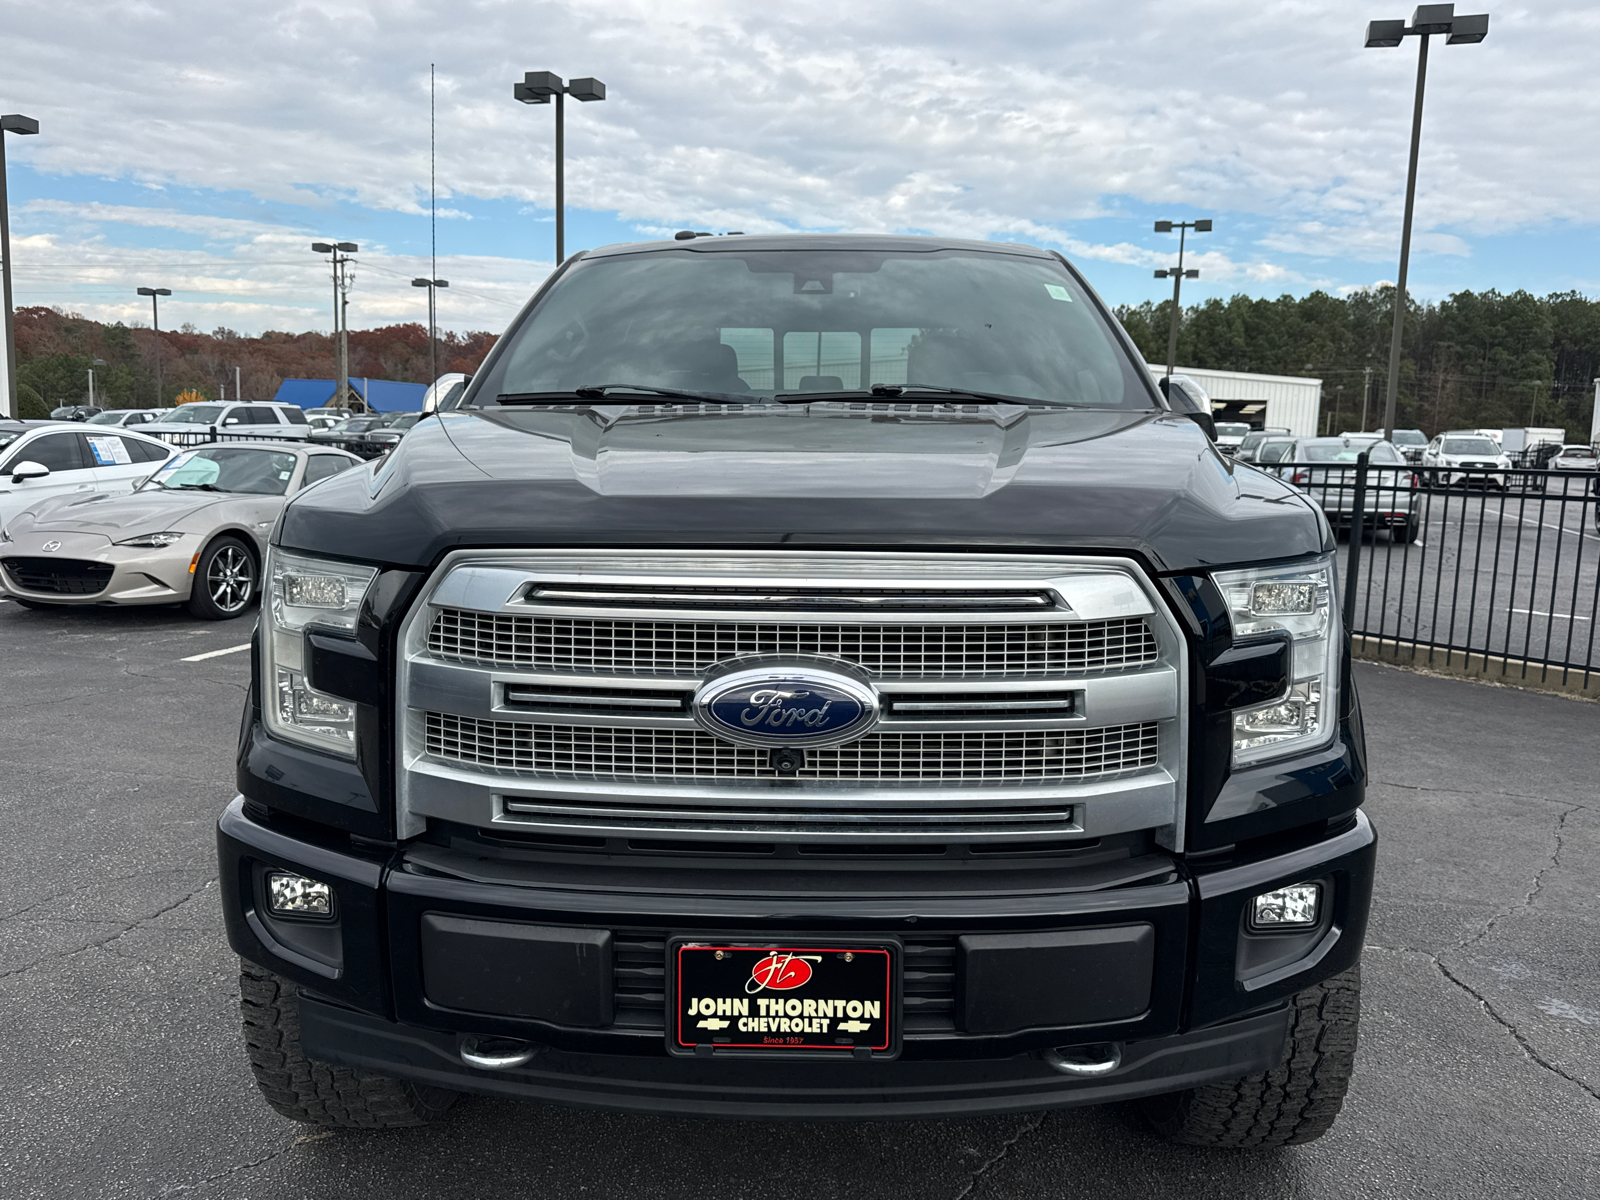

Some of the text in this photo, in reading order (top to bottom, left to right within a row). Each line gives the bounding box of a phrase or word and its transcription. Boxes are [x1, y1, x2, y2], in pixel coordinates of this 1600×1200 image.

[740, 689, 832, 727] Ford
[688, 998, 880, 1019] JOHN THORNTON
[738, 1017, 829, 1033] CHEVROLET
[763, 1036, 784, 1044] Since
